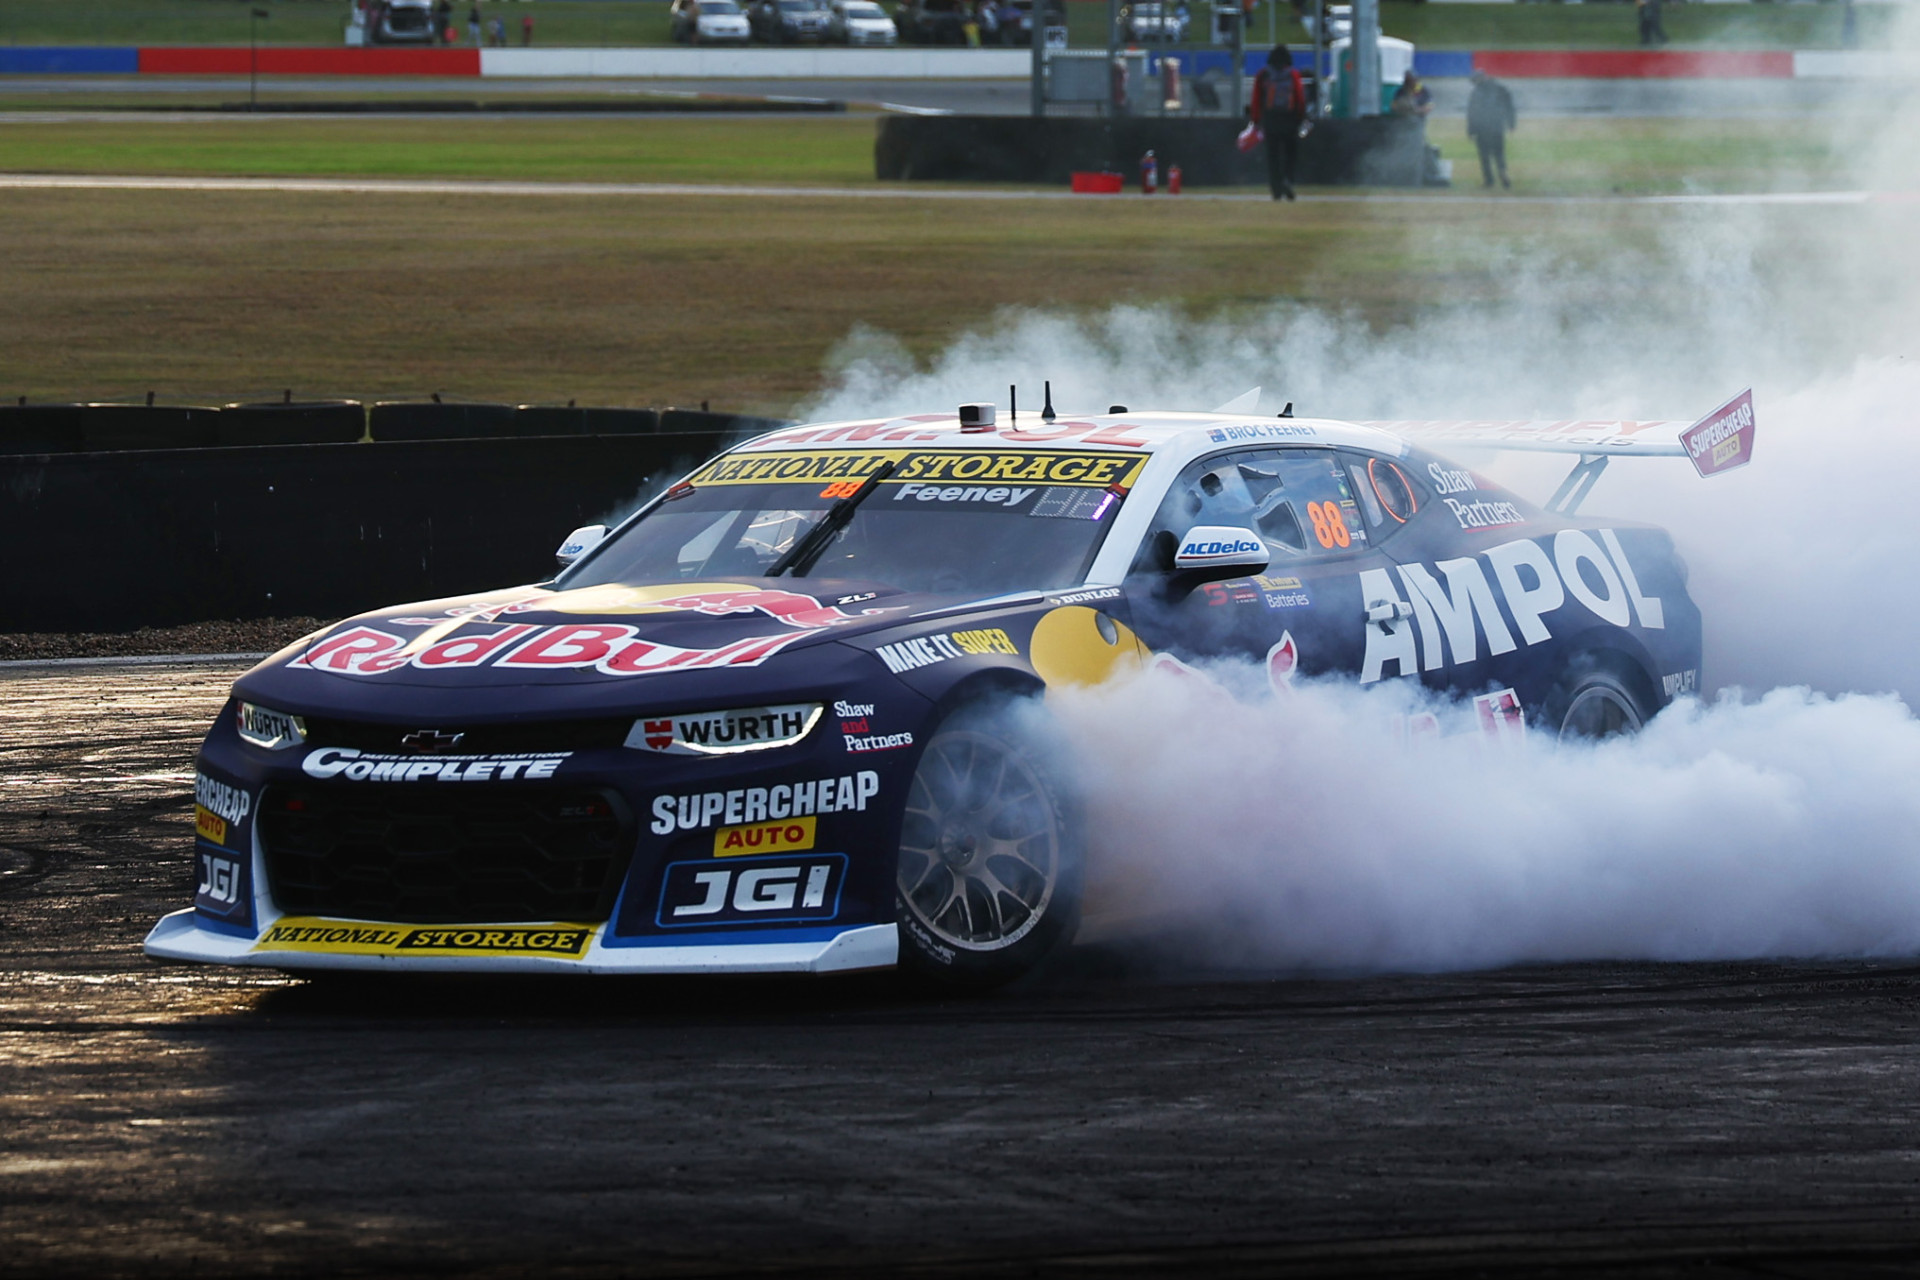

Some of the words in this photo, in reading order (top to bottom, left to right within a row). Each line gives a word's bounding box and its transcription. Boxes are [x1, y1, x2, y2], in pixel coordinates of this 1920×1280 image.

[1224, 425, 1266, 440] BROC
[1265, 424, 1318, 437] FEENEY
[1690, 402, 1752, 458] SUPERCHEAP
[1715, 440, 1738, 461] AUTO
[696, 455, 885, 483] NATIONAL
[898, 455, 1128, 483] STORAGE
[1427, 462, 1477, 494] Shaw
[819, 481, 865, 499] 88
[893, 483, 1036, 507] Feeney
[1306, 500, 1351, 549] 88
[1443, 498, 1526, 529] Partners
[1181, 539, 1260, 555] ACDelco
[1061, 588, 1121, 605] DUNLOP
[1265, 591, 1310, 609] Batteries
[1359, 528, 1666, 685] AMPOL
[285, 624, 542, 674] Red
[492, 624, 834, 675] Bull
[875, 634, 945, 674] MAKE
[936, 633, 963, 660] IT
[952, 628, 1019, 656] SUPER
[1662, 668, 1697, 697] AMPLIFY
[243, 704, 292, 741] WÜRTH
[834, 700, 875, 717] Shaw
[679, 711, 802, 744] WÜRTH
[841, 717, 869, 733] and
[843, 731, 913, 751] Partners
[302, 747, 563, 781] COMPLETE
[195, 772, 249, 827] ERCHEAP
[651, 770, 879, 835] SUPERCHEAP
[199, 812, 222, 837] AUTO
[723, 825, 805, 849] AUTO
[198, 854, 240, 904] JGI
[673, 864, 831, 916] JGI
[264, 926, 402, 947] NATIONAL
[411, 929, 579, 950] STORAGE
